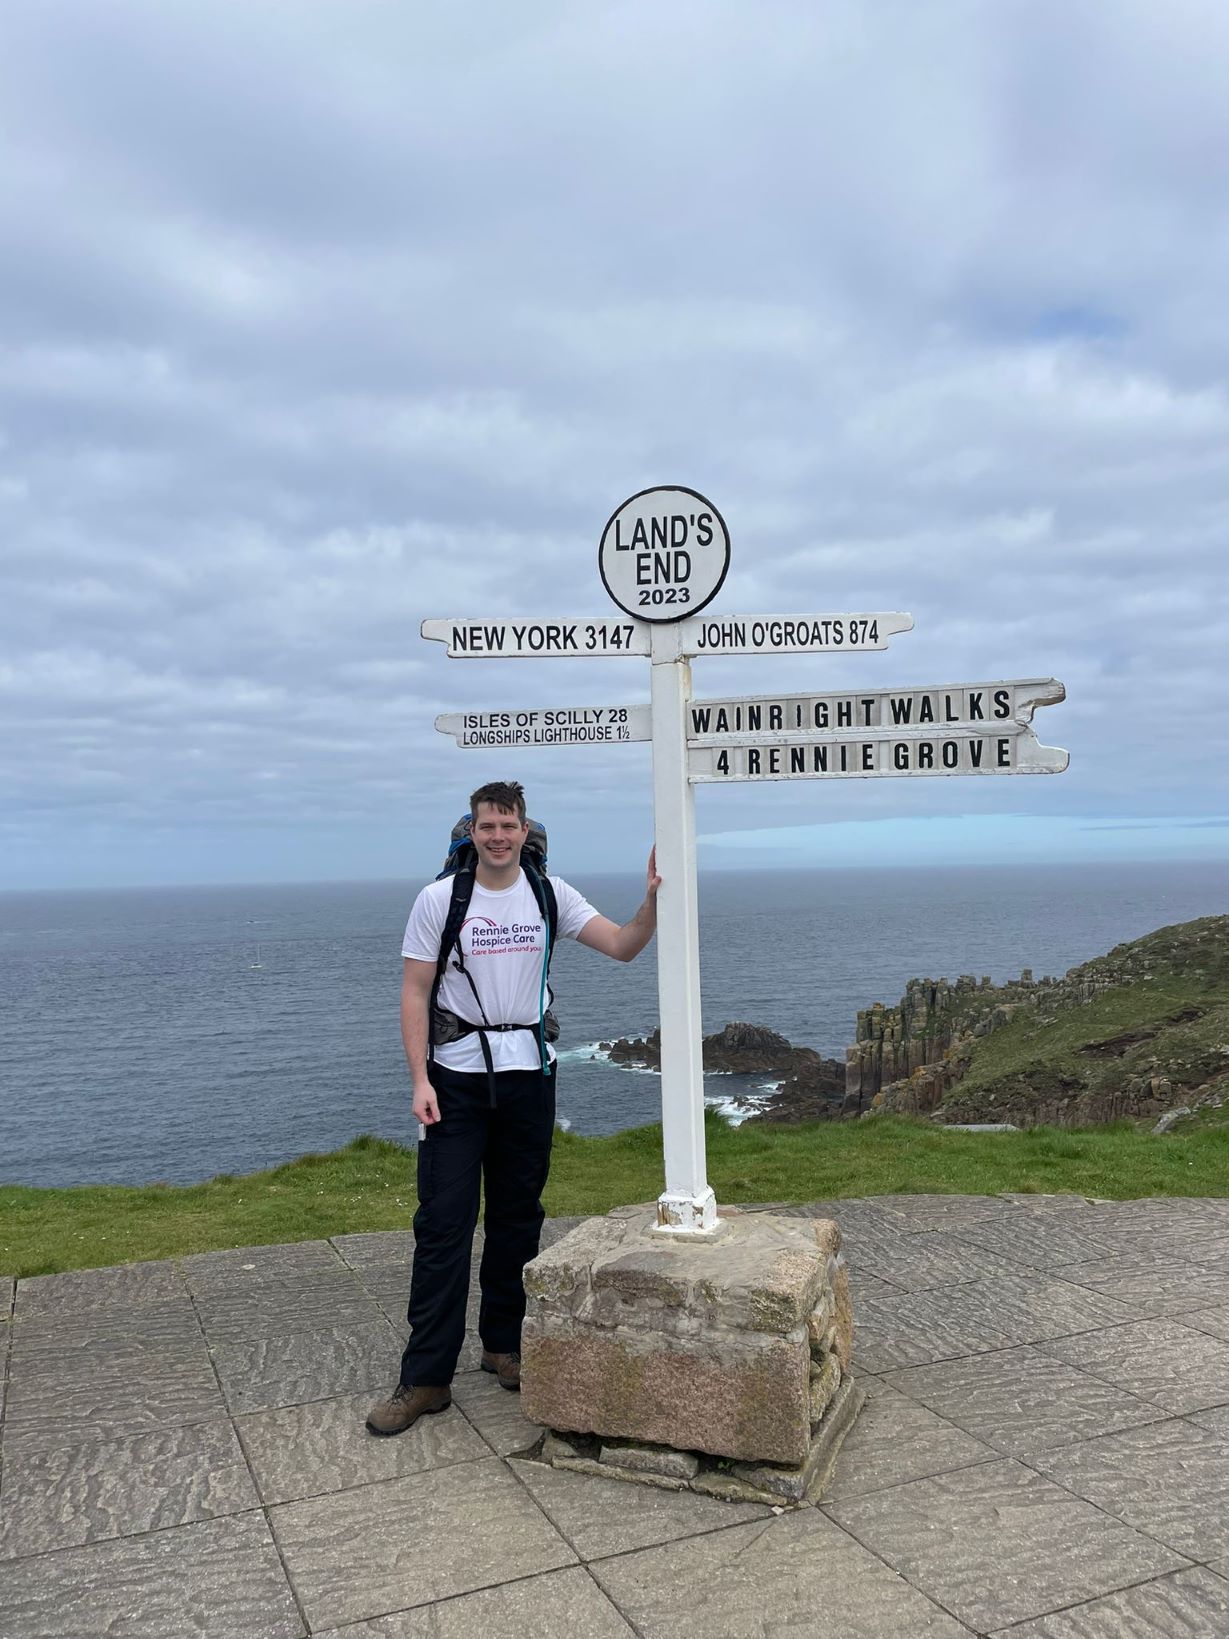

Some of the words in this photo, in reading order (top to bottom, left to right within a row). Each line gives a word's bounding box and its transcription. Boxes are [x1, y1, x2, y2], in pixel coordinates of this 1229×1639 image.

[615, 513, 713, 551] LAND'S
[636, 550, 691, 585] END
[638, 587, 690, 606] 2023
[452, 626, 506, 650] NEW
[512, 625, 578, 650] YORK
[585, 625, 635, 649] 3147
[697, 623, 746, 648] JOHN
[752, 621, 844, 647] O'GROATS
[849, 619, 879, 644] 874
[463, 713, 510, 728] ISLES
[516, 712, 538, 727] OF
[544, 709, 604, 727] SCILLY
[608, 709, 628, 723] 28
[691, 699, 875, 733] WAINRIGHT
[891, 690, 1010, 724] WALKS
[463, 728, 531, 745] LONGSHIPS
[534, 726, 611, 743] LIGHTHOUSE
[716, 750, 730, 775] 4
[748, 743, 875, 775] RENNIE
[894, 738, 1011, 769] GROVE
[471, 936, 511, 948] Hospice
[513, 934, 535, 944] Care
[472, 924, 509, 937] Rennie
[511, 923, 541, 934] Grove
[488, 947, 507, 955] based
[507, 945, 529, 953] around
